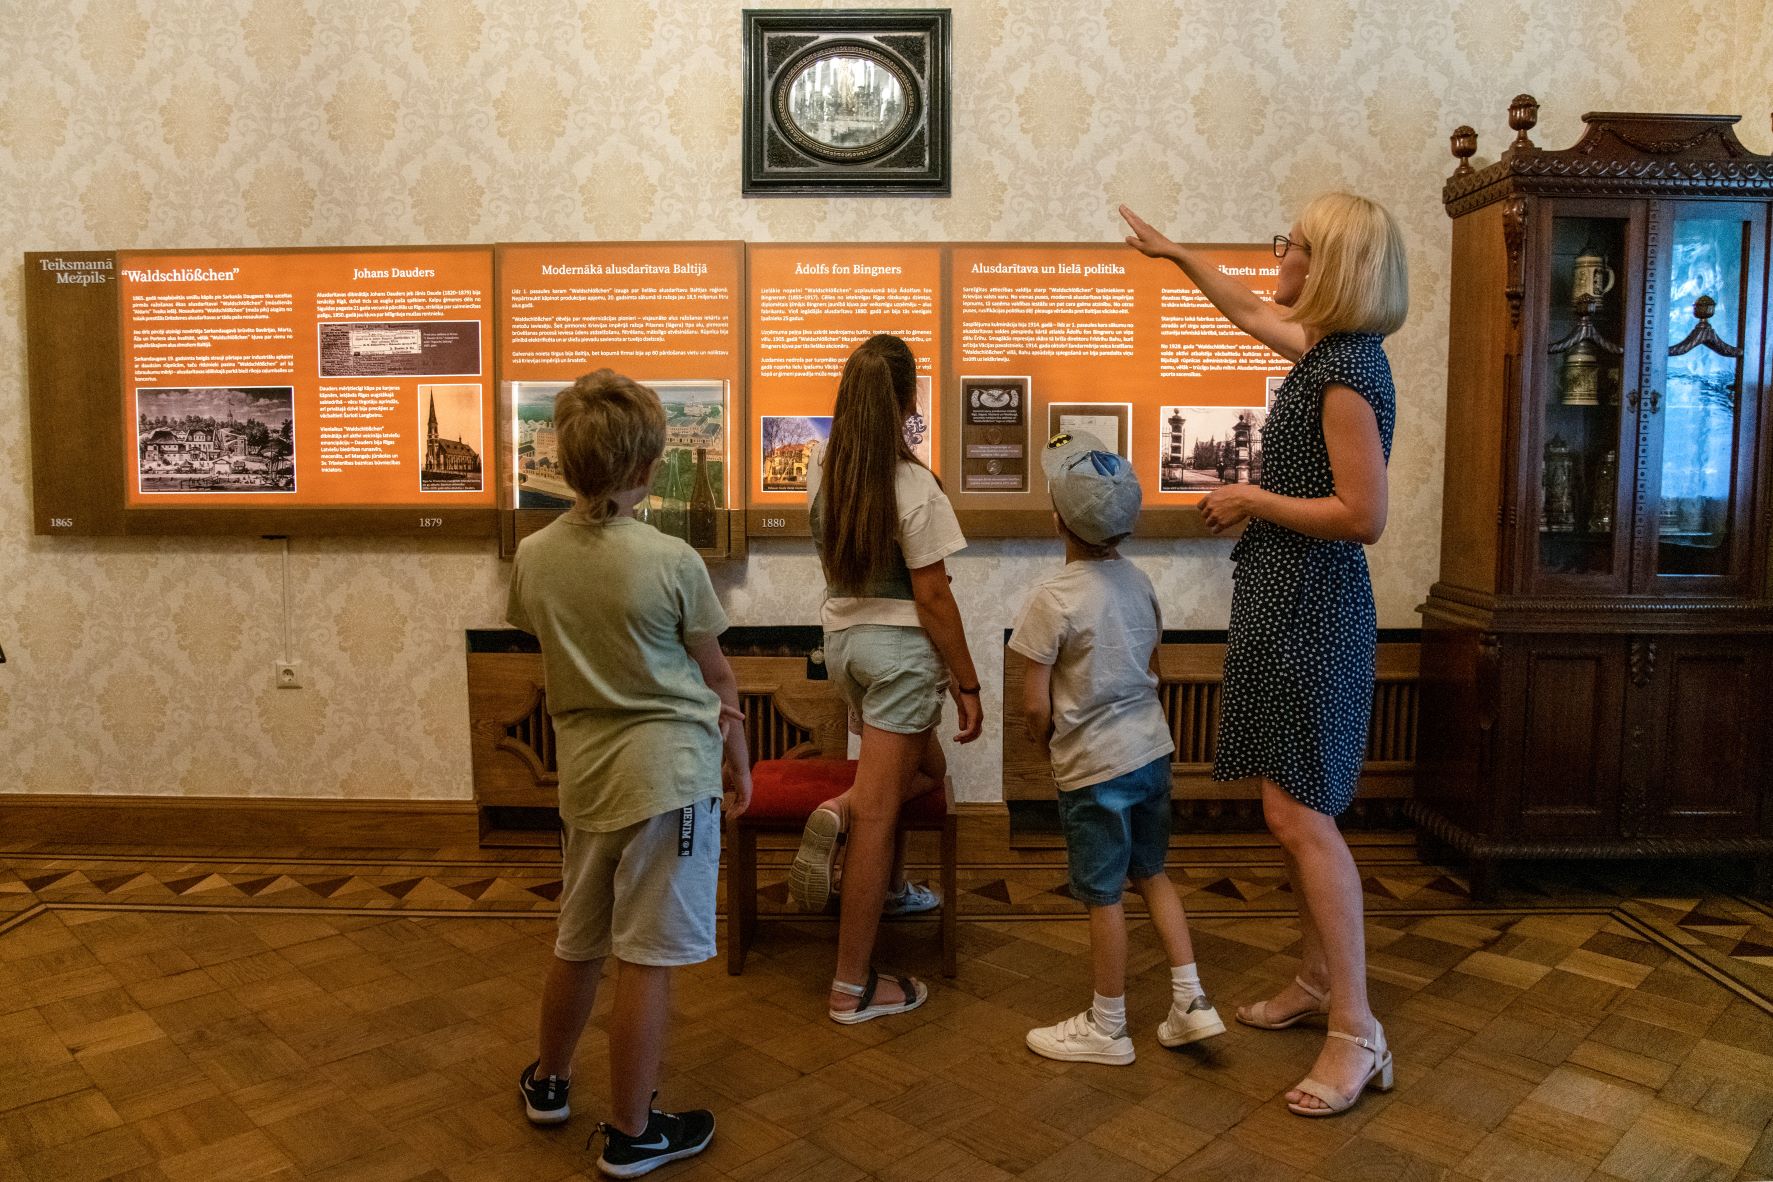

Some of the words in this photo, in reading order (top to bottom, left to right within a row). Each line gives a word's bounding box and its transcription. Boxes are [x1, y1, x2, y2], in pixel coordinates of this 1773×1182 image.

[353, 268, 389, 280] Johans
[392, 267, 435, 278] Dauders
[542, 264, 603, 275] Modernākā
[605, 264, 670, 274] alusdarītava
[673, 264, 708, 276] Baltijā
[795, 263, 829, 274] Ādolfs
[832, 264, 850, 274] fon
[853, 264, 902, 276] Bingners
[971, 263, 1039, 273] Alusdarītava
[1041, 266, 1056, 274] un
[1058, 264, 1081, 274] lielā
[1084, 264, 1125, 276] politika
[56, 272, 106, 286] Mežpils
[50, 518, 73, 527] 1865
[419, 518, 442, 527] 1879
[762, 518, 785, 528] 1880
[682, 807, 692, 839] DENIM
